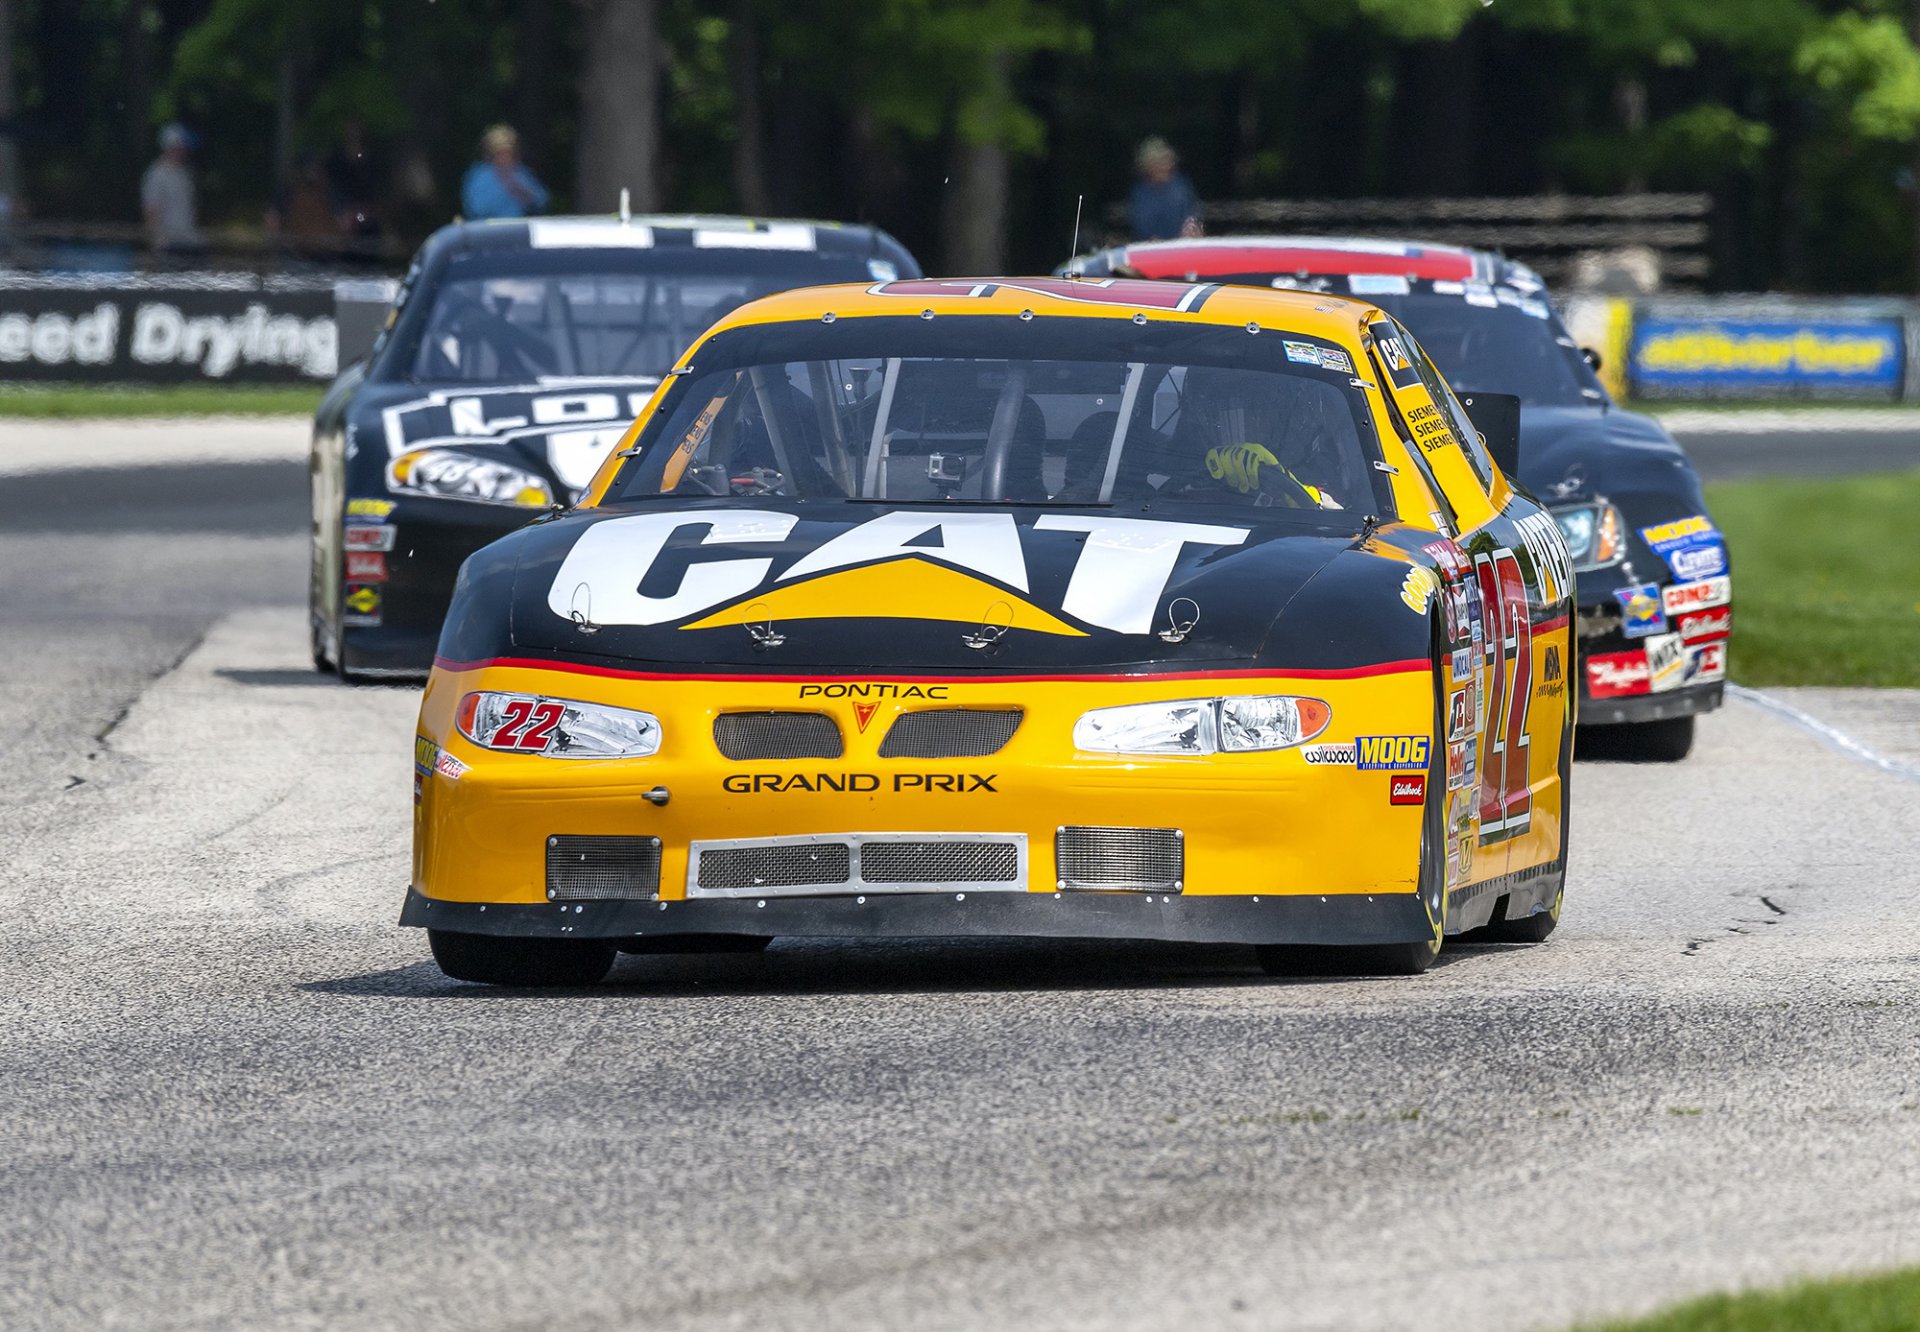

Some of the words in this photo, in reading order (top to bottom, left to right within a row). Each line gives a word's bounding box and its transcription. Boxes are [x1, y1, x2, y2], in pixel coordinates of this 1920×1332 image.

[0, 303, 119, 364] eed
[131, 302, 338, 376] Drying
[1380, 337, 1412, 371] CA
[450, 393, 654, 435] LO
[1643, 516, 1712, 544] MOOG
[548, 509, 1250, 634] CAT
[799, 684, 949, 699] PONTIAC
[488, 700, 567, 751] 22
[1359, 737, 1427, 763] MOOG
[722, 774, 880, 792] GRAND
[894, 774, 998, 792] PRIX
[1393, 783, 1422, 796] Edelbrock
